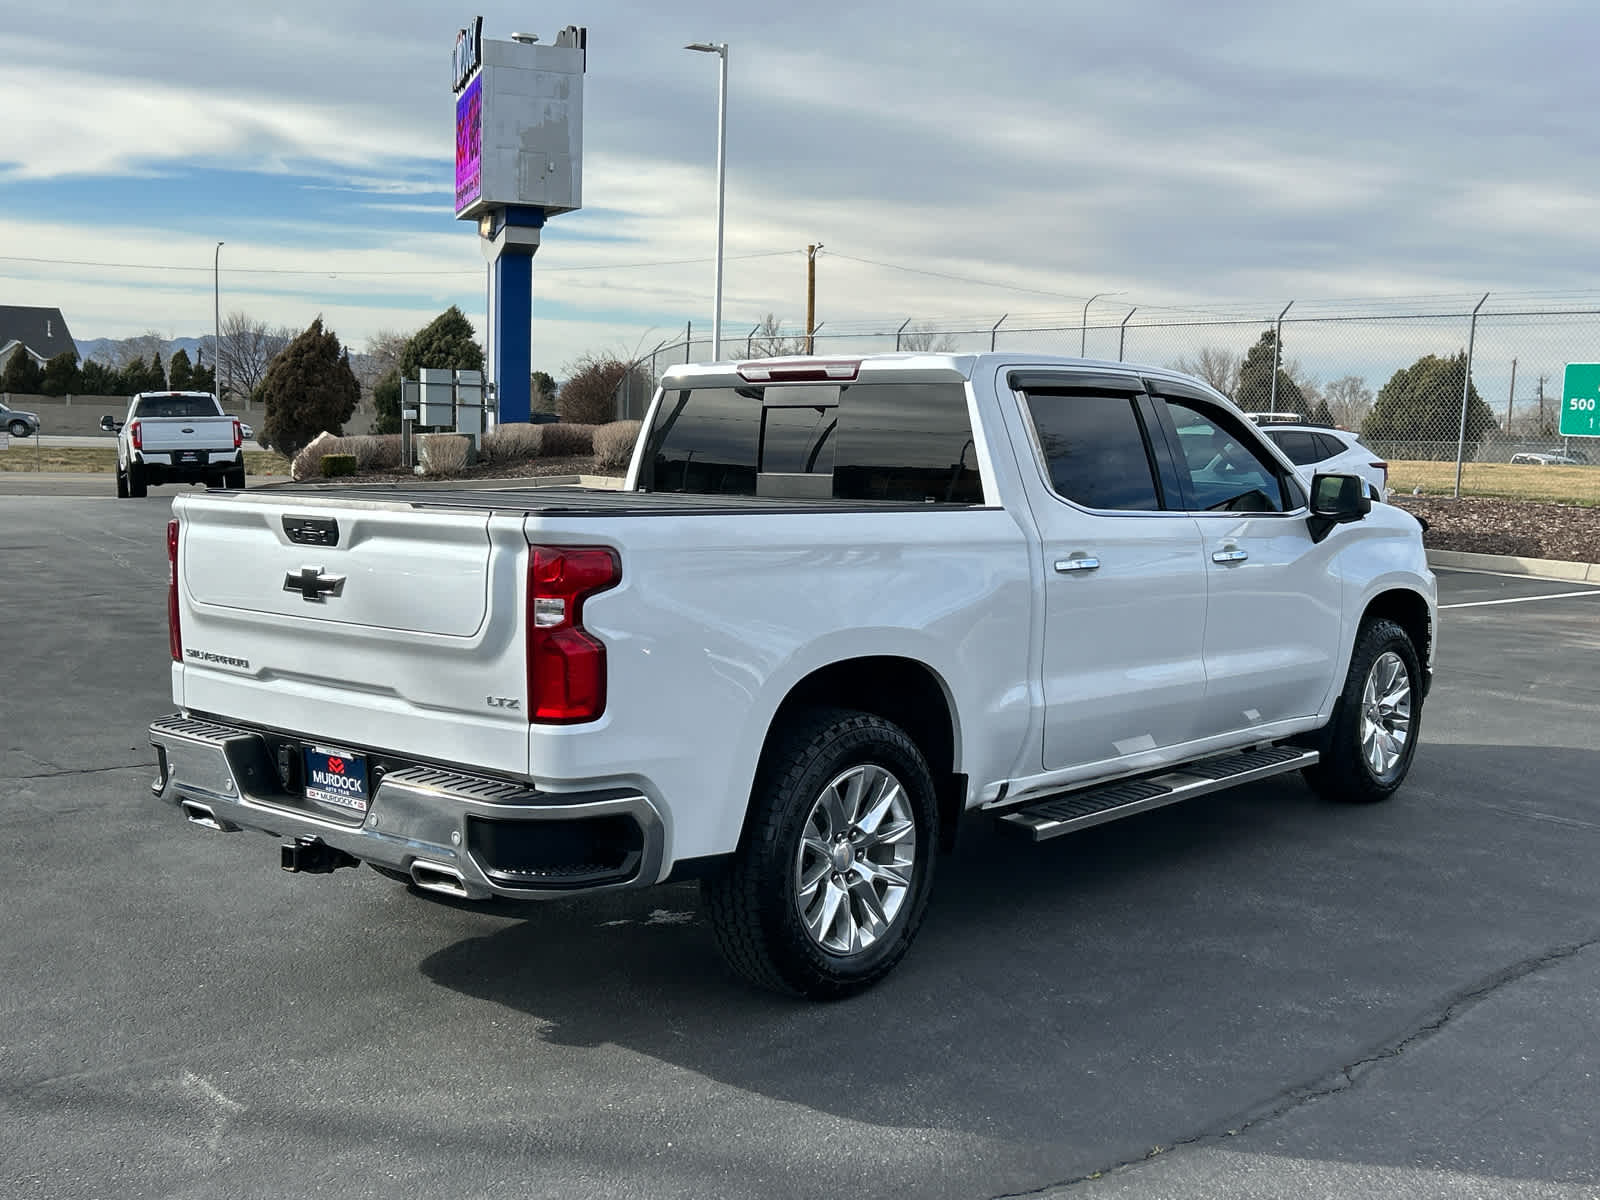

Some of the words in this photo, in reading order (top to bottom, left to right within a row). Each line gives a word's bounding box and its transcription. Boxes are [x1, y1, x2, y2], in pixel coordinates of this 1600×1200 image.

[1569, 398, 1596, 411] 500
[185, 648, 250, 669] SILVERADO
[486, 696, 520, 709] LTZ
[312, 770, 362, 793] MURDOCK
[320, 793, 353, 806] MURDOCK
